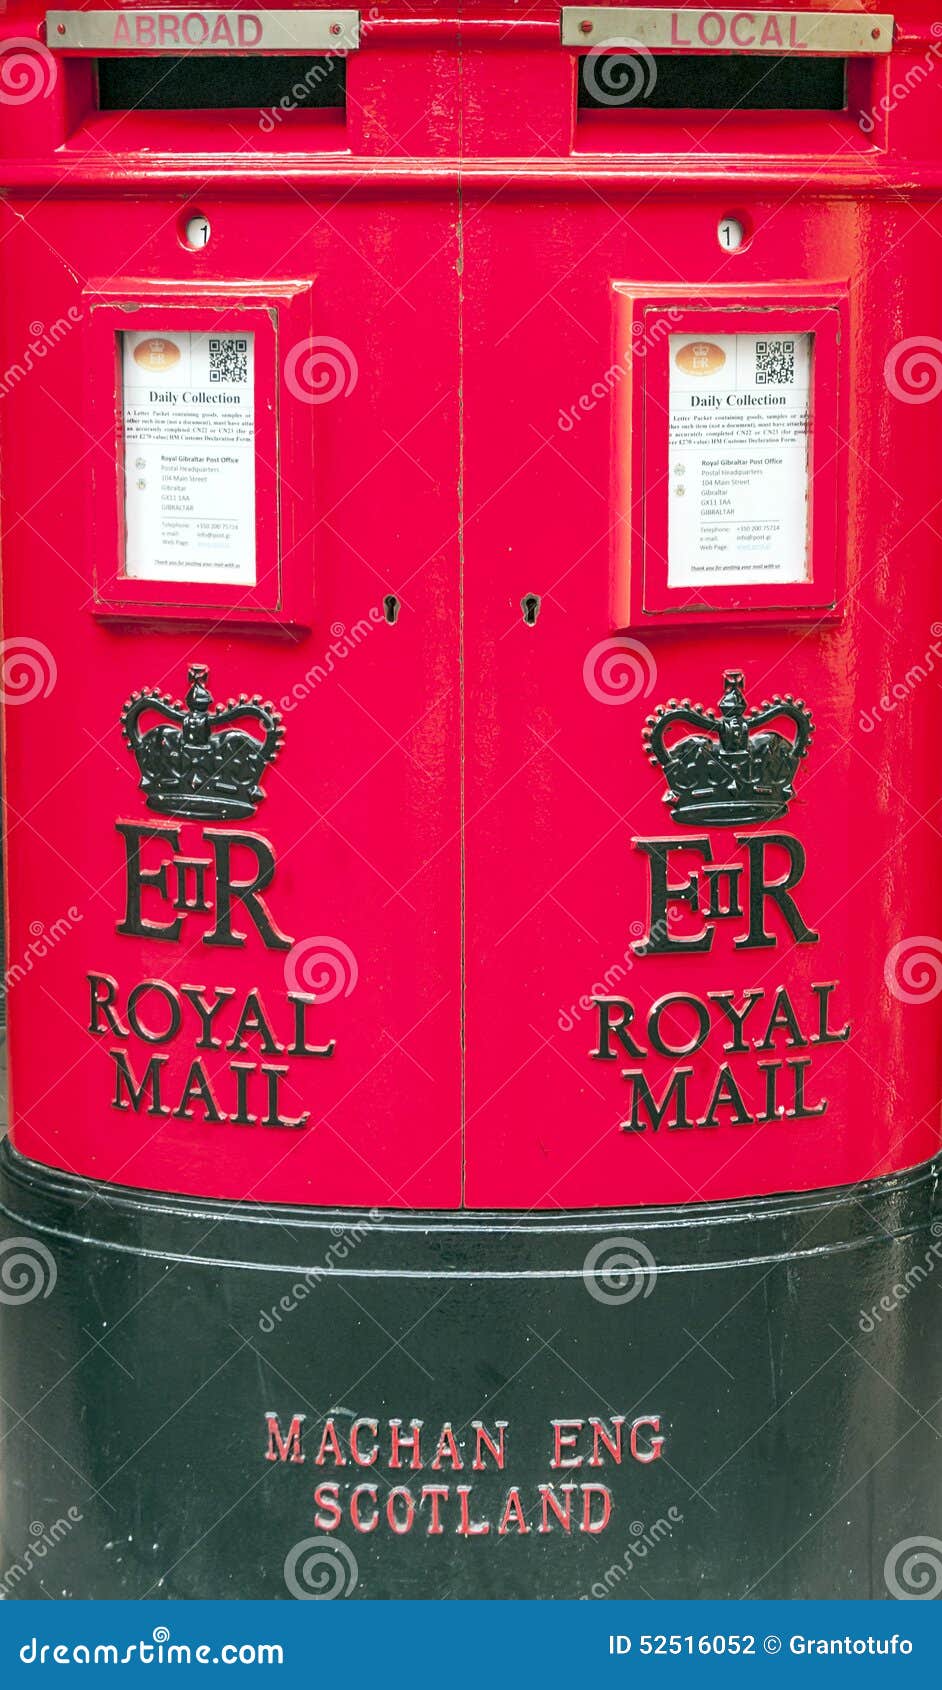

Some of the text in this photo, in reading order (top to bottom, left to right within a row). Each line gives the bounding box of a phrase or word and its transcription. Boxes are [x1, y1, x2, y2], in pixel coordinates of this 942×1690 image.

[113, 13, 263, 47] ABROAD
[670, 12, 808, 48] LOCAL
[200, 225, 208, 245] 1
[722, 226, 731, 246] 1
[149, 391, 241, 406] Daily Collection
[691, 394, 786, 409] Daily Collection
[161, 455, 178, 463] Royal
[701, 459, 719, 467] Royal
[87, 970, 336, 1057] ROYAL
[589, 980, 850, 1060] ROYAL
[109, 1048, 311, 1128] MAIL
[619, 1056, 828, 1133] MAIL
[264, 1412, 665, 1470] MACHAN ENG
[314, 1482, 613, 1535] SCOTLAND
